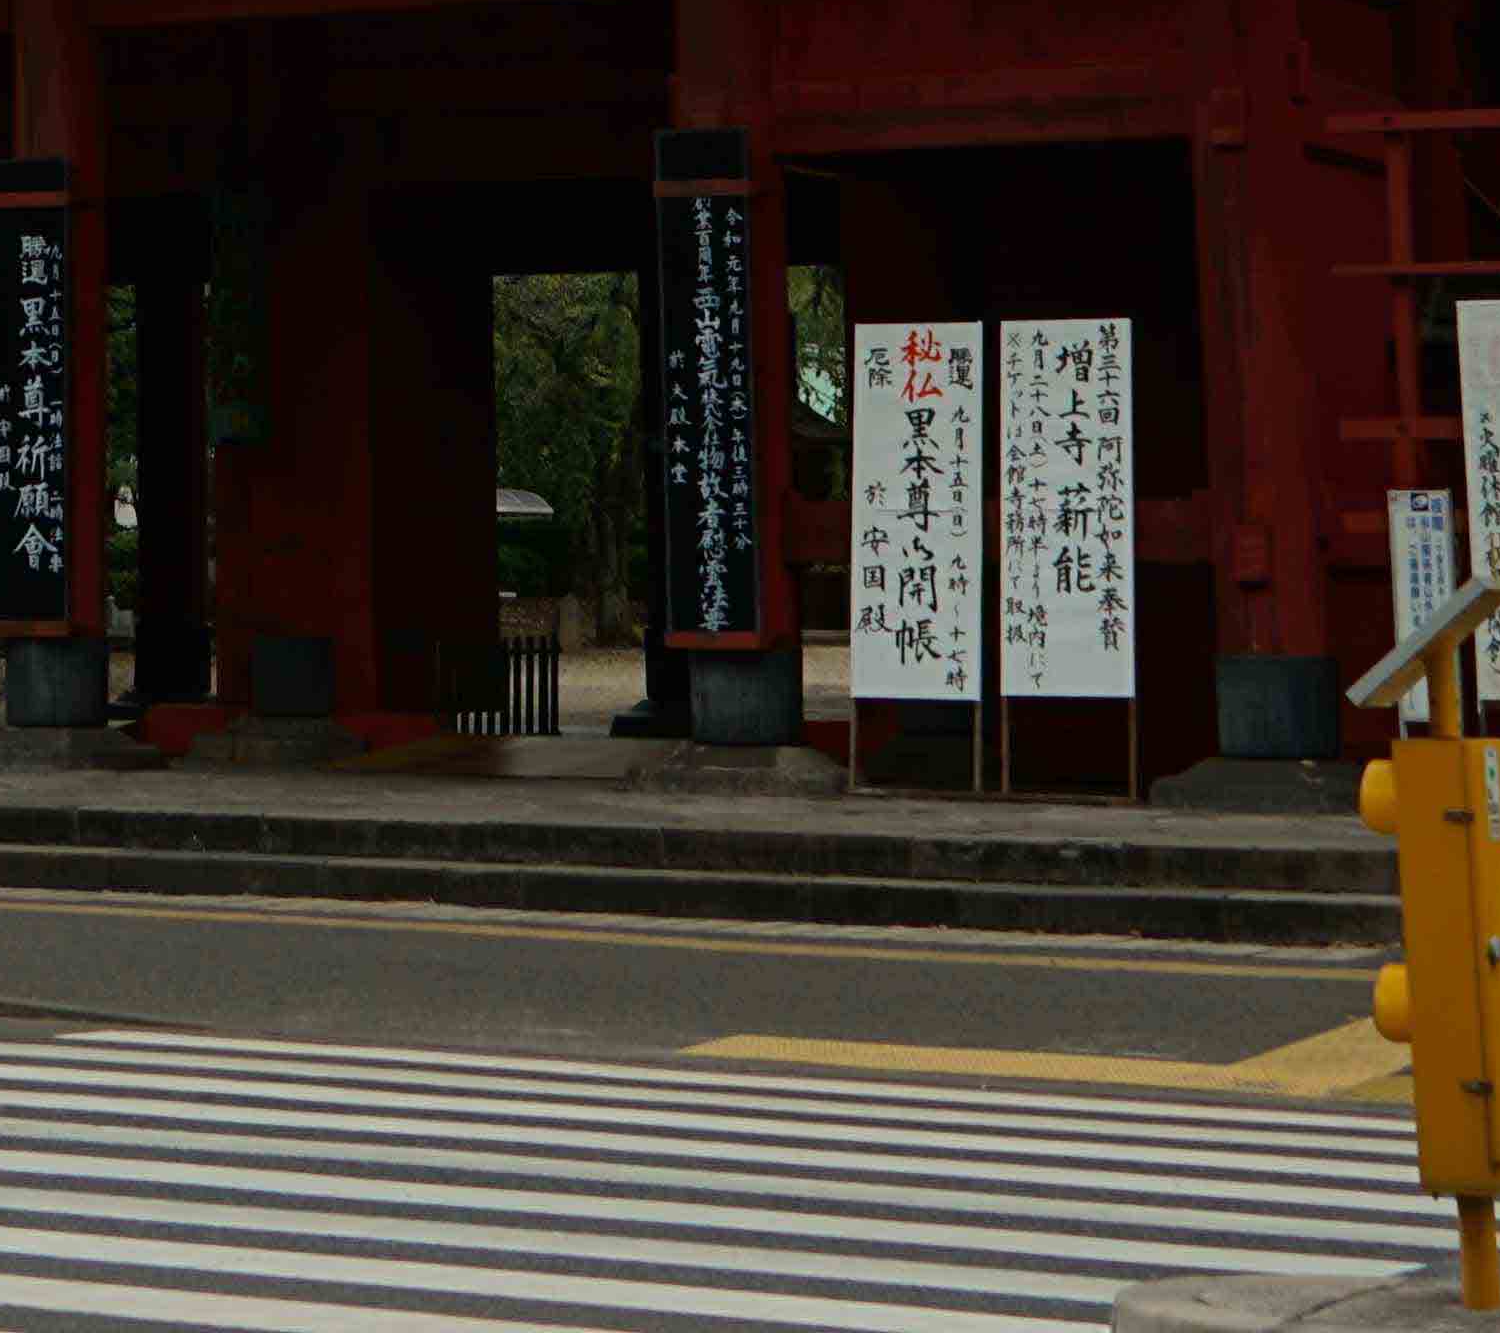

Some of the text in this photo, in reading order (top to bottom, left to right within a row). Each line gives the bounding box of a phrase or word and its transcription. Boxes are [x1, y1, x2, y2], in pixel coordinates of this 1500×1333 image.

[864, 347, 892, 389] 厄除
[1054, 341, 1093, 466] 増上寺
[1096, 322, 1121, 426] 第三十六回
